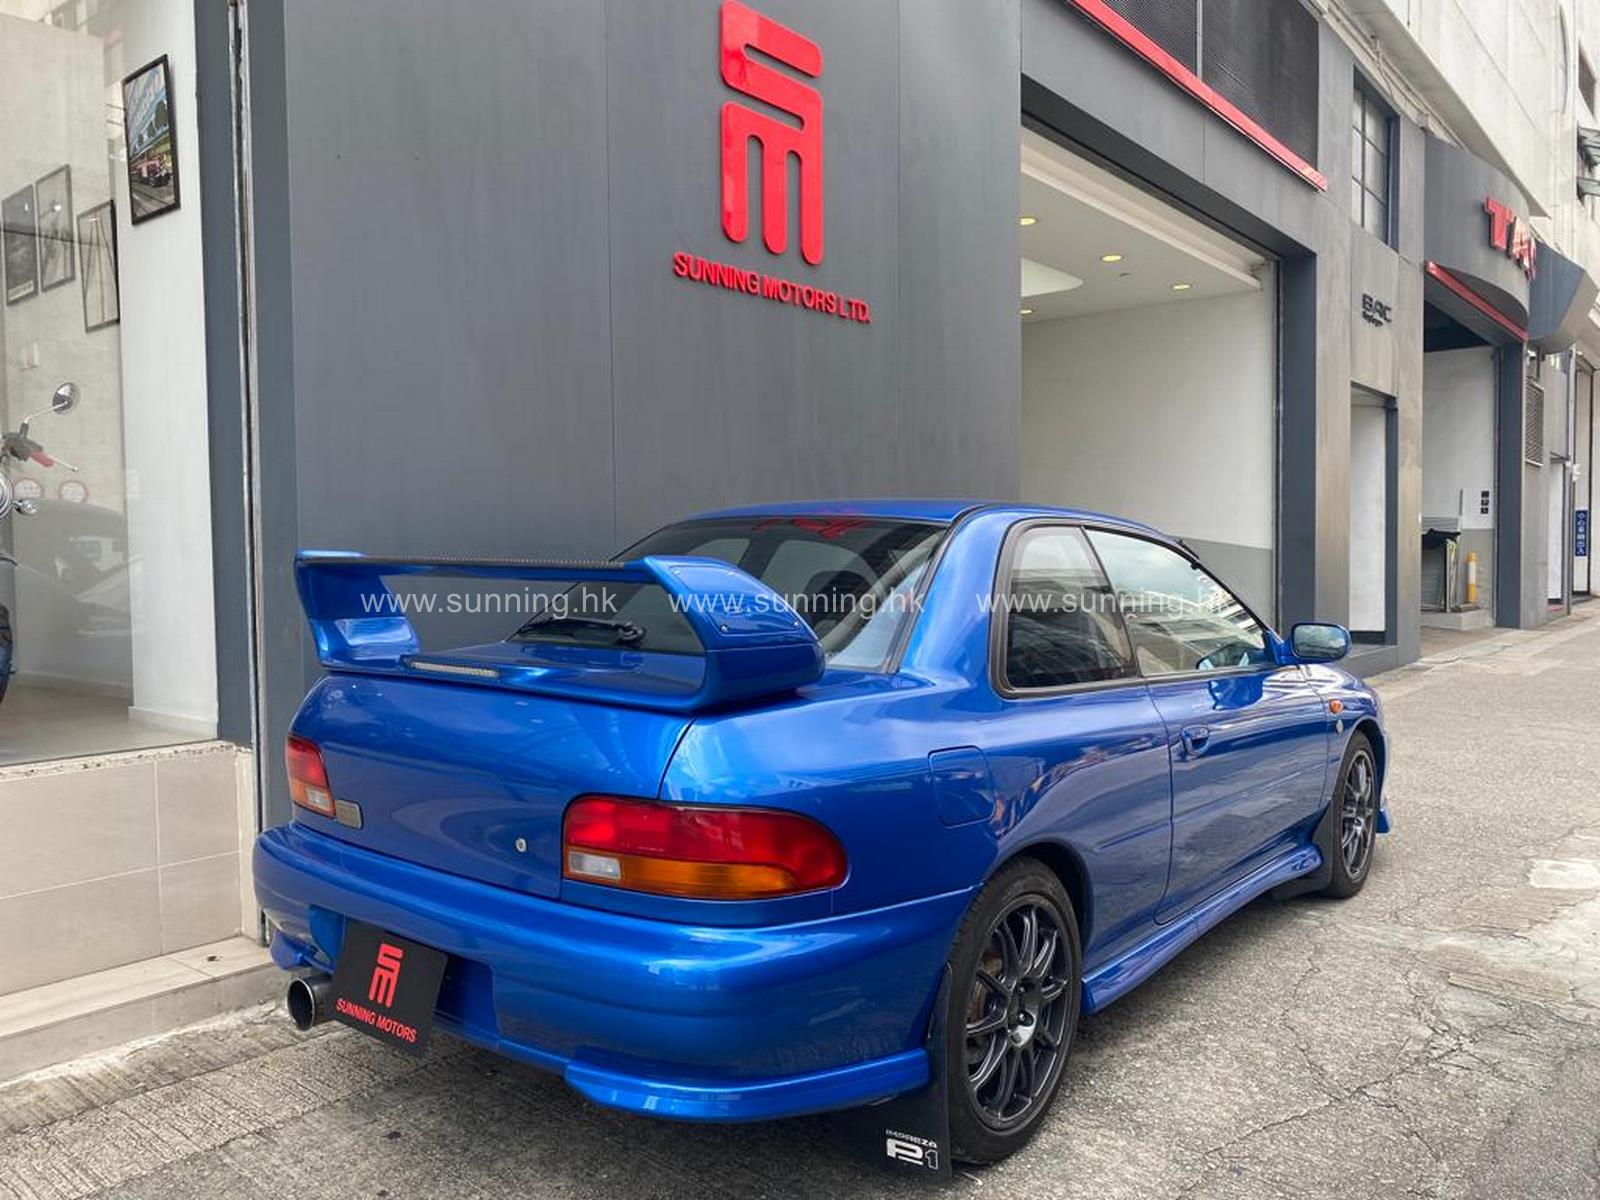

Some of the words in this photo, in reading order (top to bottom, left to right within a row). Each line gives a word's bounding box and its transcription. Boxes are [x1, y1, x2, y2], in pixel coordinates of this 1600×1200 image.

[1483, 194, 1537, 282] TA
[673, 251, 761, 294] SUNNING
[761, 277, 837, 312] MOTORS
[336, 998, 376, 1025] SUNNING
[376, 1016, 417, 1043] MOTORS
[886, 1138, 939, 1170] P1
